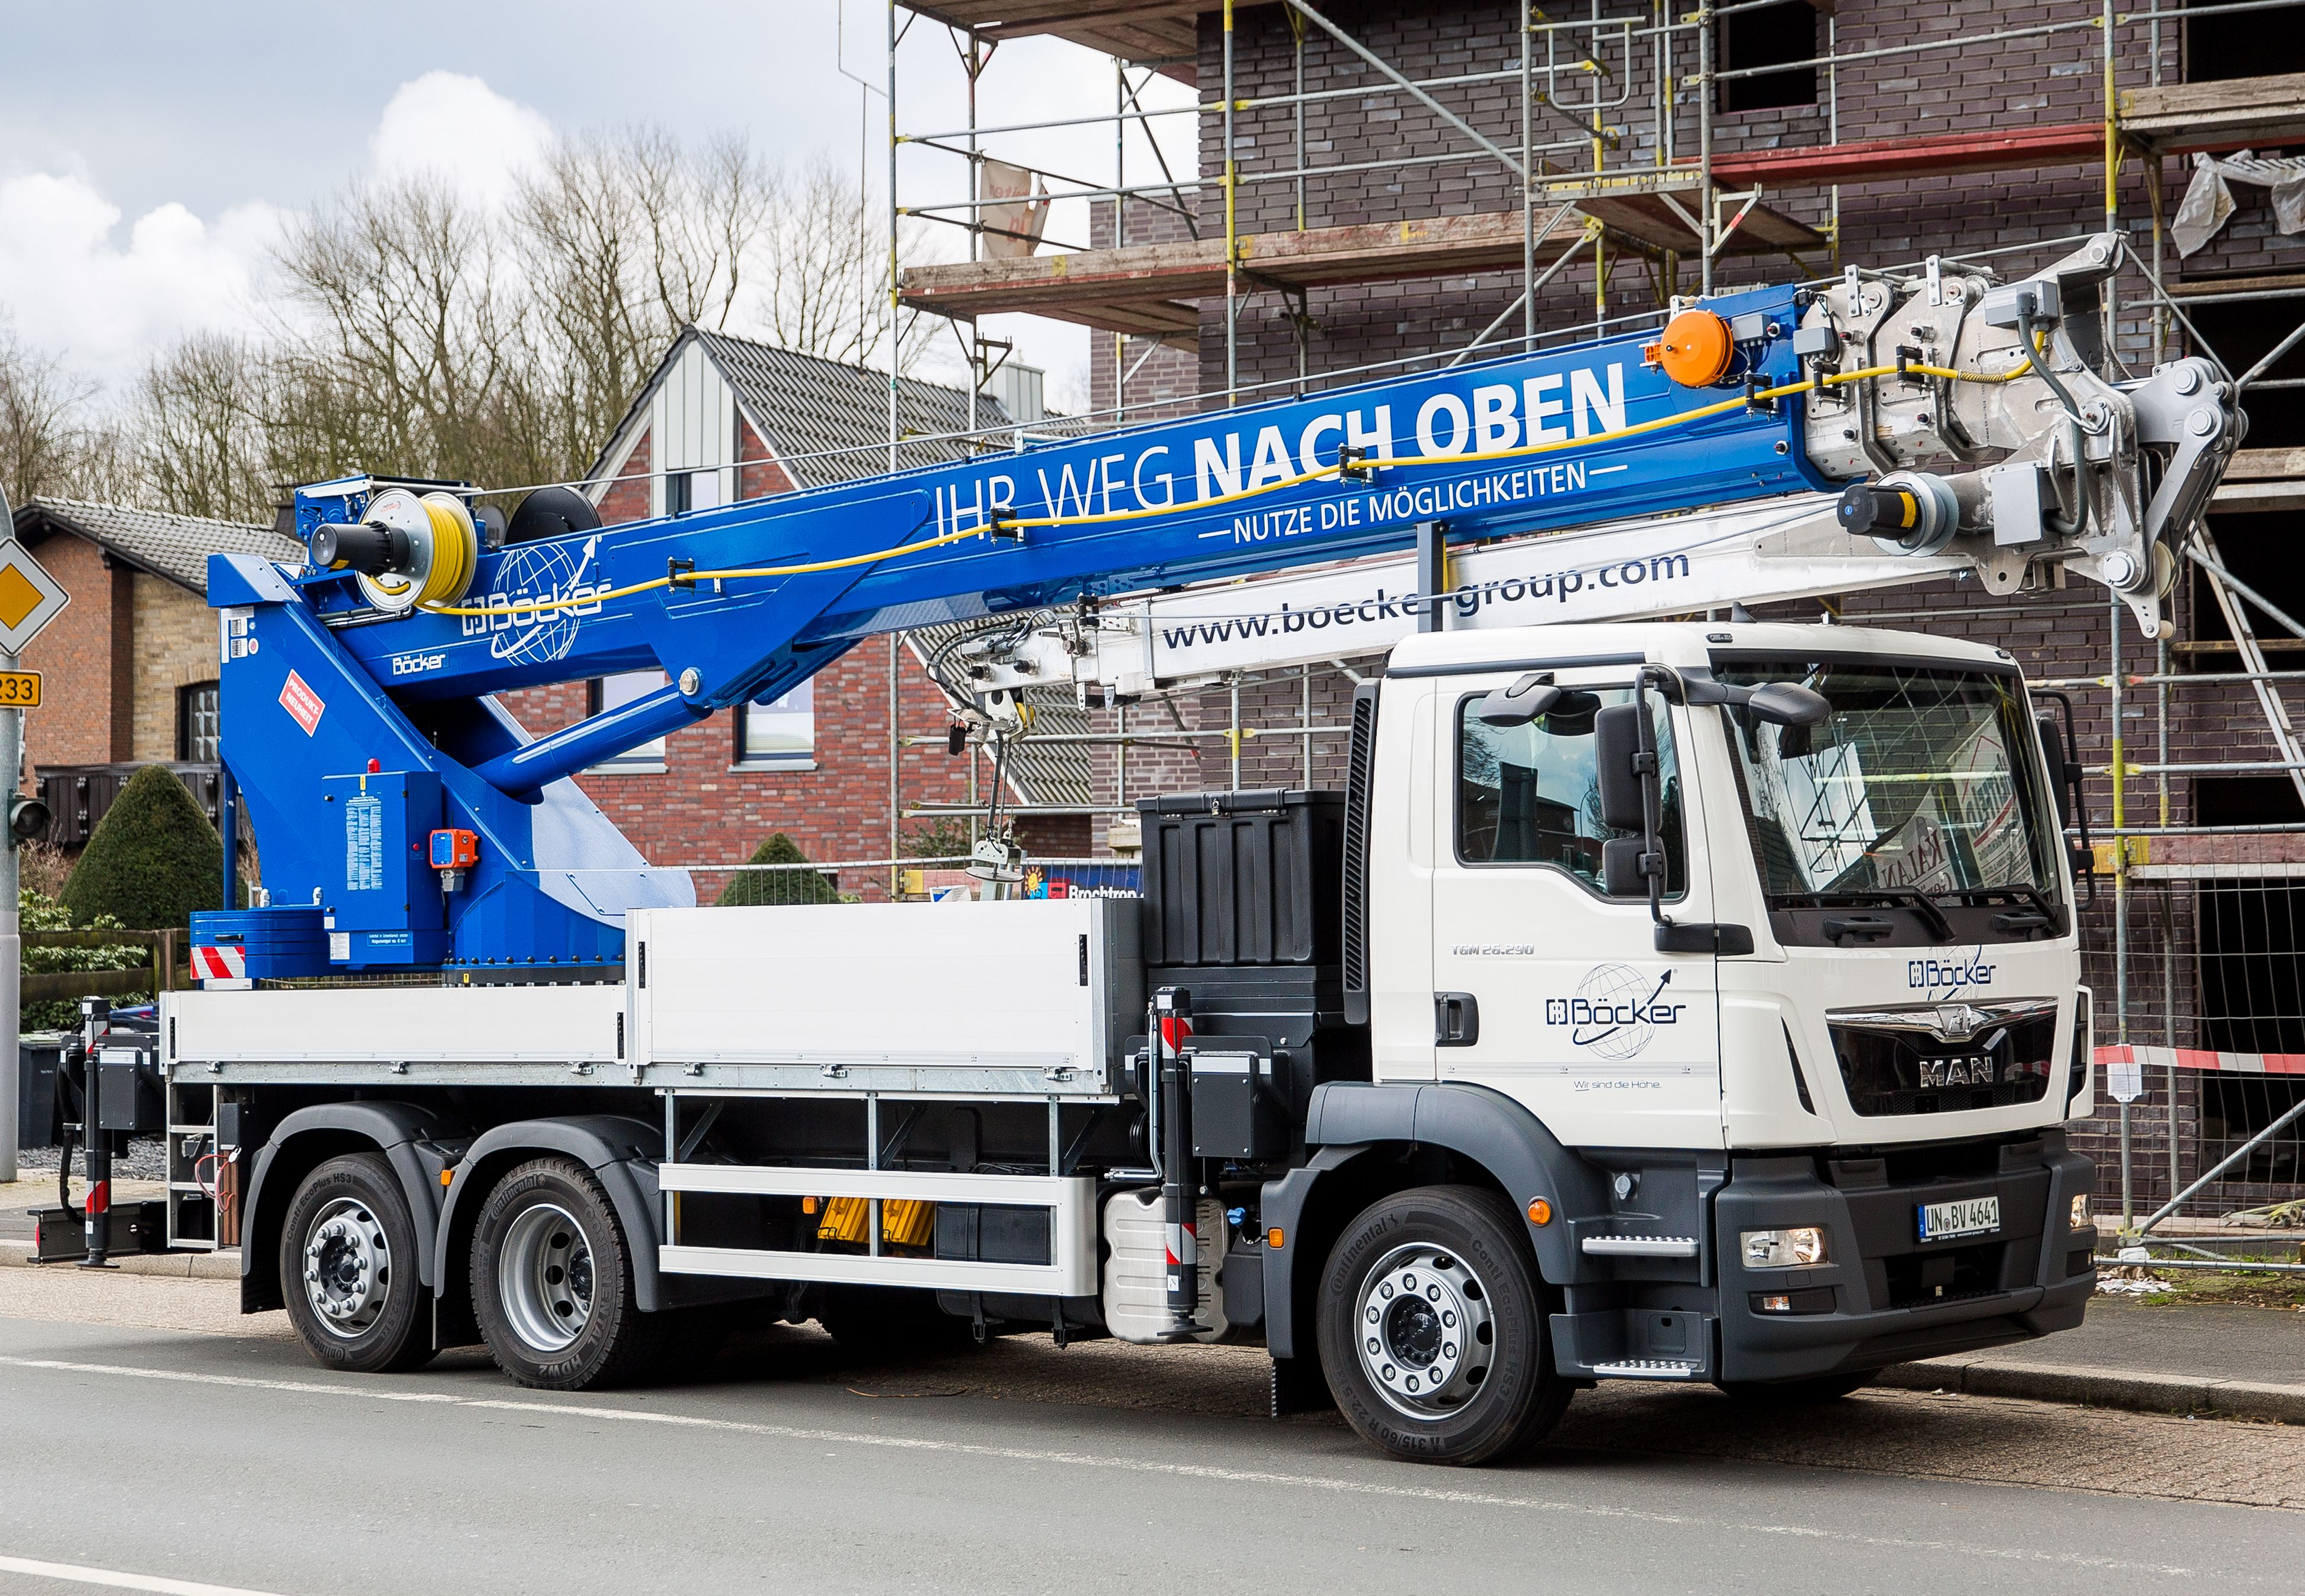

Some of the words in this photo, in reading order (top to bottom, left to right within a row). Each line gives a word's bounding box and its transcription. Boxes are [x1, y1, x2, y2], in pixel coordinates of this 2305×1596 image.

[936, 475, 1024, 547] IHR
[1037, 446, 1174, 528] WEG
[1193, 403, 1395, 500] NACH
[1415, 362, 1627, 458] OBEN
[1233, 506, 1312, 544] NUTZE
[1321, 498, 1361, 526] DIE
[1368, 461, 1586, 522] MÖGLICHKEITEN
[488, 582, 612, 632] Böcker
[1163, 550, 1690, 650] www.boecke-group.com
[392, 654, 446, 675] Böcker
[285, 691, 314, 725] NEUHEIT
[288, 678, 319, 716] PRODUKT-
[1452, 944, 1479, 955] TGM
[1482, 944, 1535, 955] 26.290
[1926, 958, 1997, 987] Böcker
[1572, 998, 1687, 1025] Böcker
[1573, 1081, 1589, 1091] Wir
[1592, 1080, 1612, 1089] sind
[1614, 1080, 1629, 1089] die
[1631, 1080, 1662, 1089] Höhe.
[1920, 1056, 1994, 1088] MAN
[287, 1205, 300, 1240] Conti
[300, 1175, 331, 1208] EcoPlus
[333, 1172, 352, 1185] HS3
[491, 1173, 537, 1221] Continental
[1926, 1207, 1943, 1233] UN
[1950, 1204, 1966, 1230] BV
[1970, 1200, 1998, 1226] 4641
[585, 1205, 613, 1344] CONTINENTAL
[1330, 1217, 1389, 1296] Continental
[1472, 1239, 1504, 1281] Conti
[1498, 1282, 1518, 1355] EcoPlus
[299, 1327, 346, 1362] Continental
[538, 1354, 585, 1377] HDW2
[1499, 1360, 1518, 1397] HS3
[1368, 1418, 1379, 1431] R
[1381, 1429, 1426, 1451] 315/60
